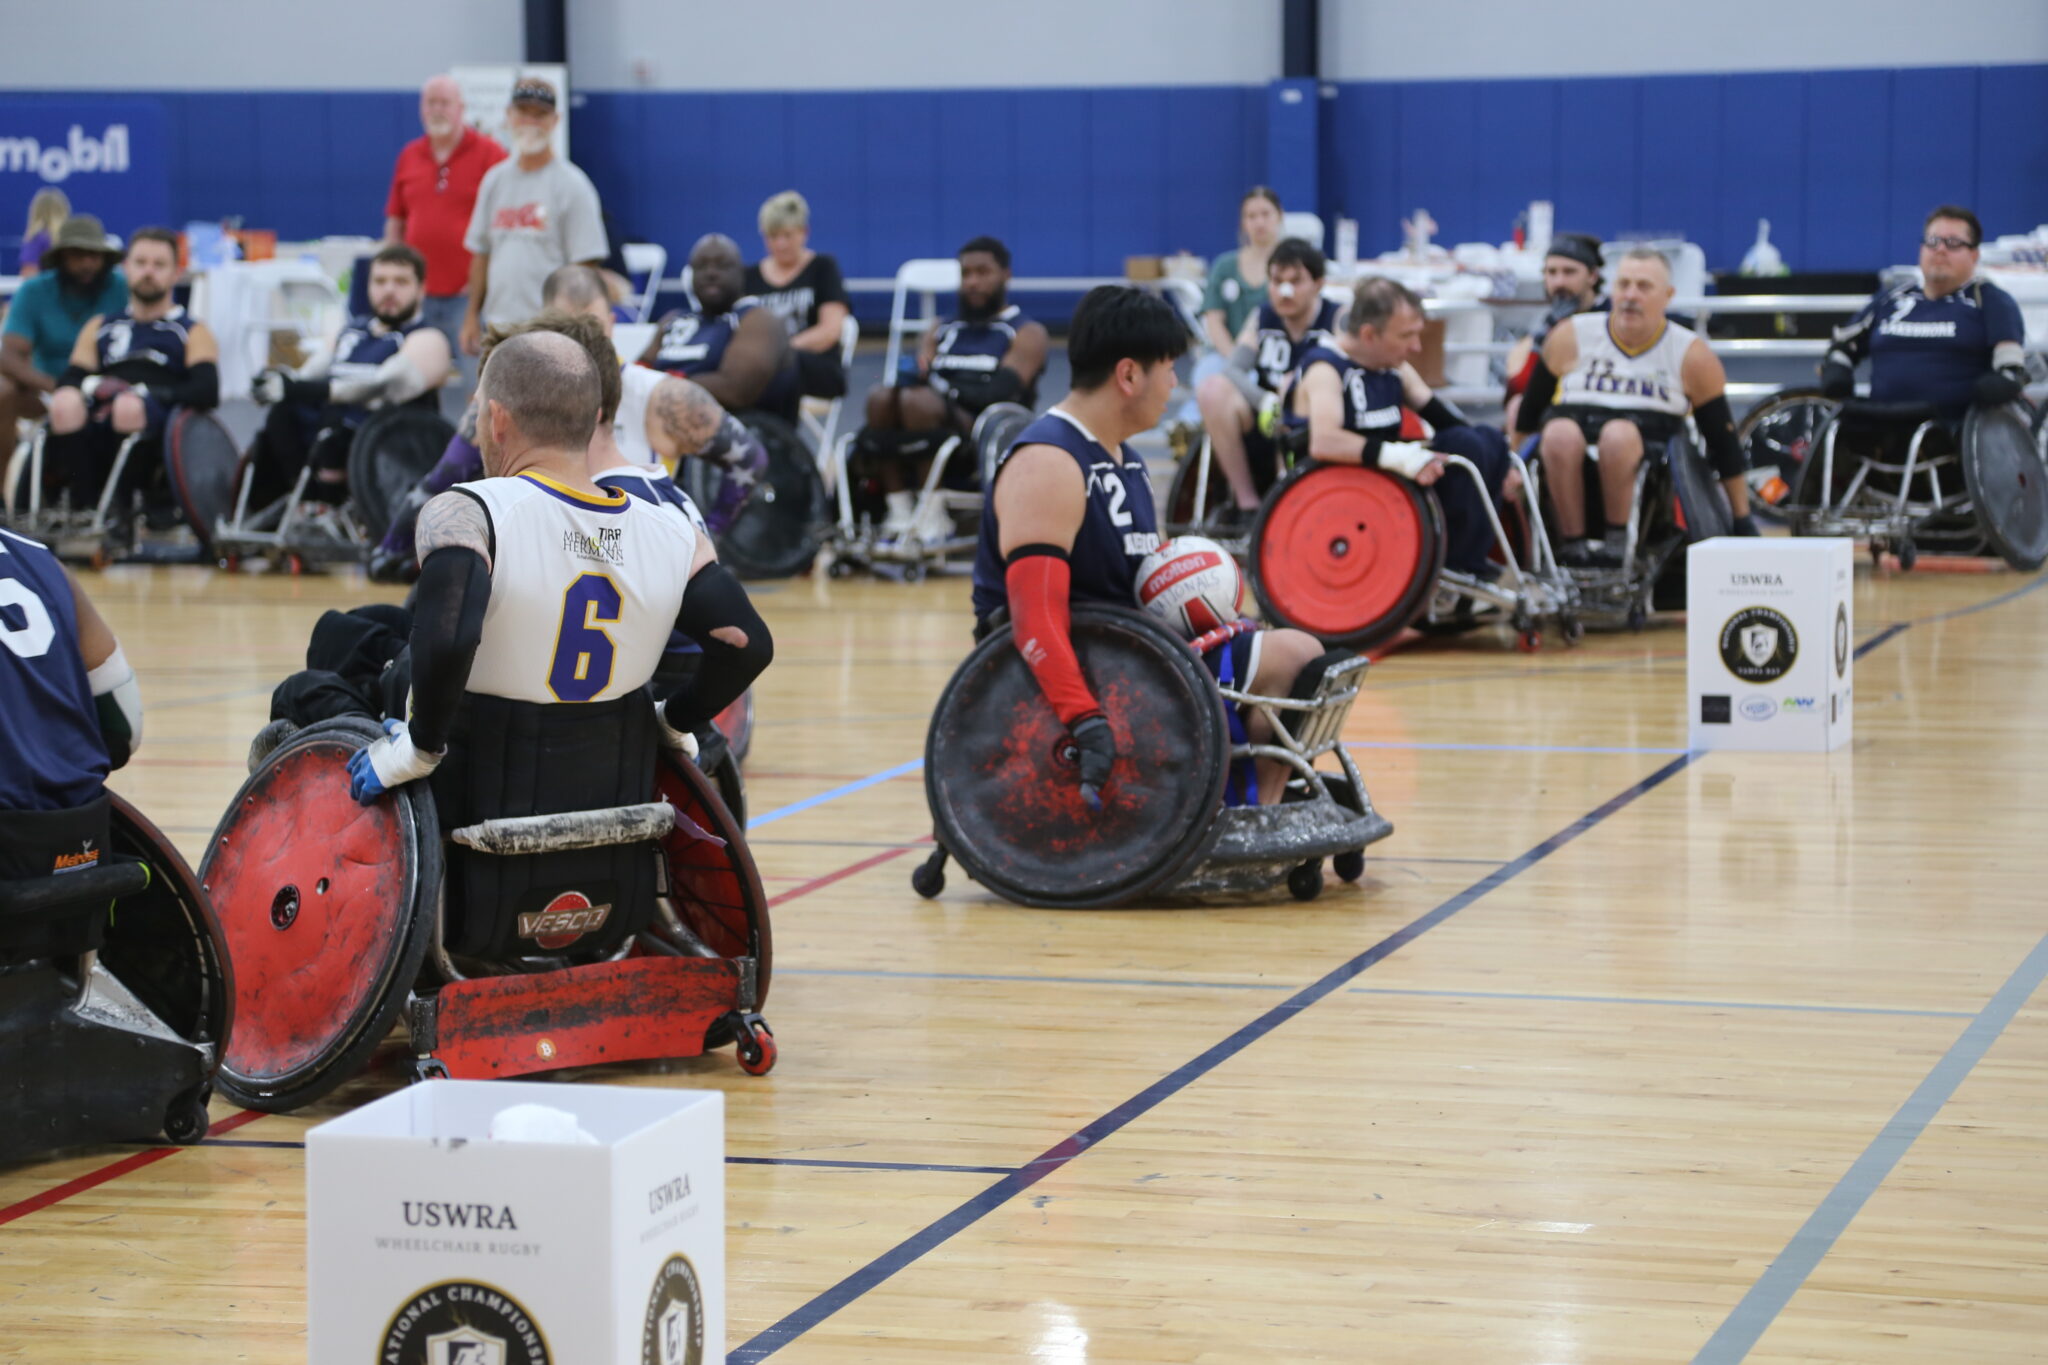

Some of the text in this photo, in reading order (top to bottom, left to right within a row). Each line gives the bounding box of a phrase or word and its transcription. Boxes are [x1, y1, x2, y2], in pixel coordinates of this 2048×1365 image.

[1150, 554, 1206, 594] molten
[1730, 572, 1784, 587] USWRA
[545, 570, 625, 704] 6
[649, 1172, 692, 1215] USWRA
[402, 1201, 518, 1231] USWRA
[374, 1236, 542, 1256] WHEELCHAIR RUGBY
[385, 1291, 443, 1365] ATIONAL
